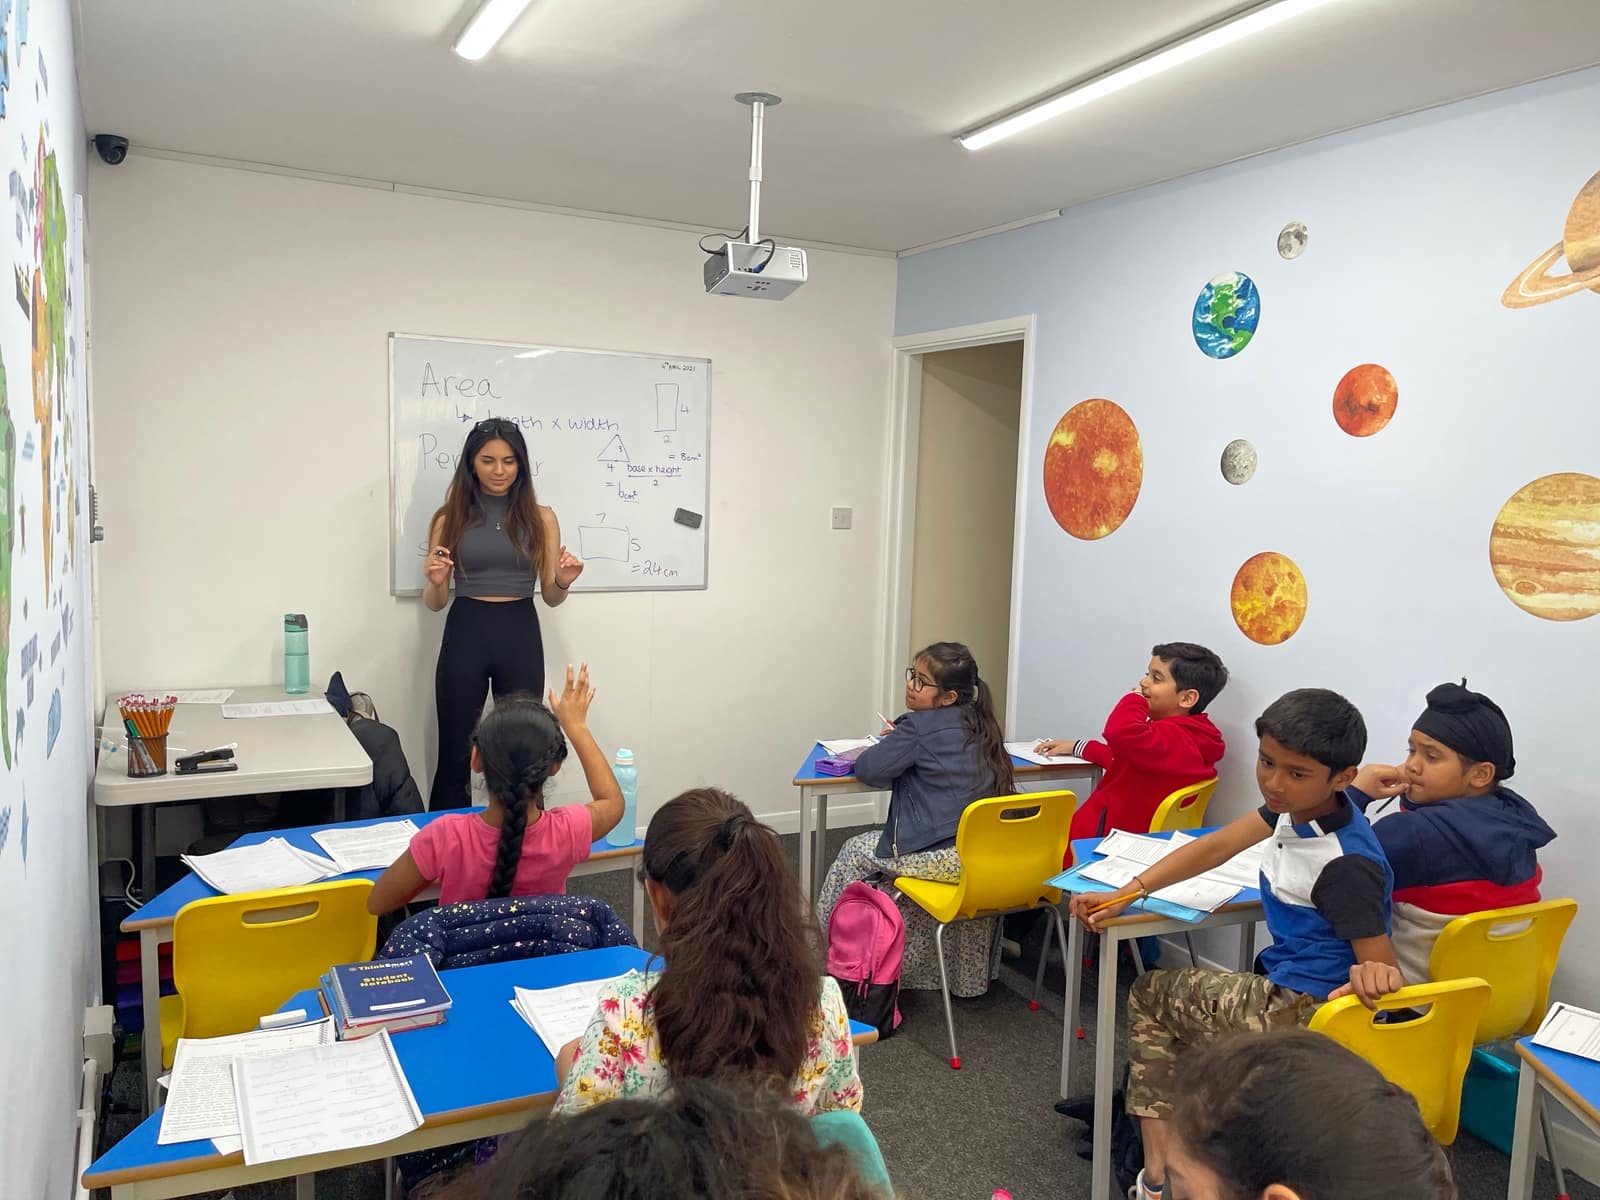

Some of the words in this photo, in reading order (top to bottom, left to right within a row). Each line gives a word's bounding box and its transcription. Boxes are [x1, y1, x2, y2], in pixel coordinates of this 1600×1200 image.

[421, 362, 502, 399] Area
[680, 403, 689, 414] 4
[568, 415, 619, 431] width
[663, 434, 672, 444] 2
[607, 463, 615, 472] 4
[627, 463, 646, 473] base
[655, 464, 682, 478] height
[652, 479, 659, 487] 2
[595, 512, 607, 524] 7
[630, 538, 642, 552] 5
[358, 960, 413, 971] ThinkSmart
[360, 976, 414, 988] Notebook
[363, 973, 408, 983] Student
